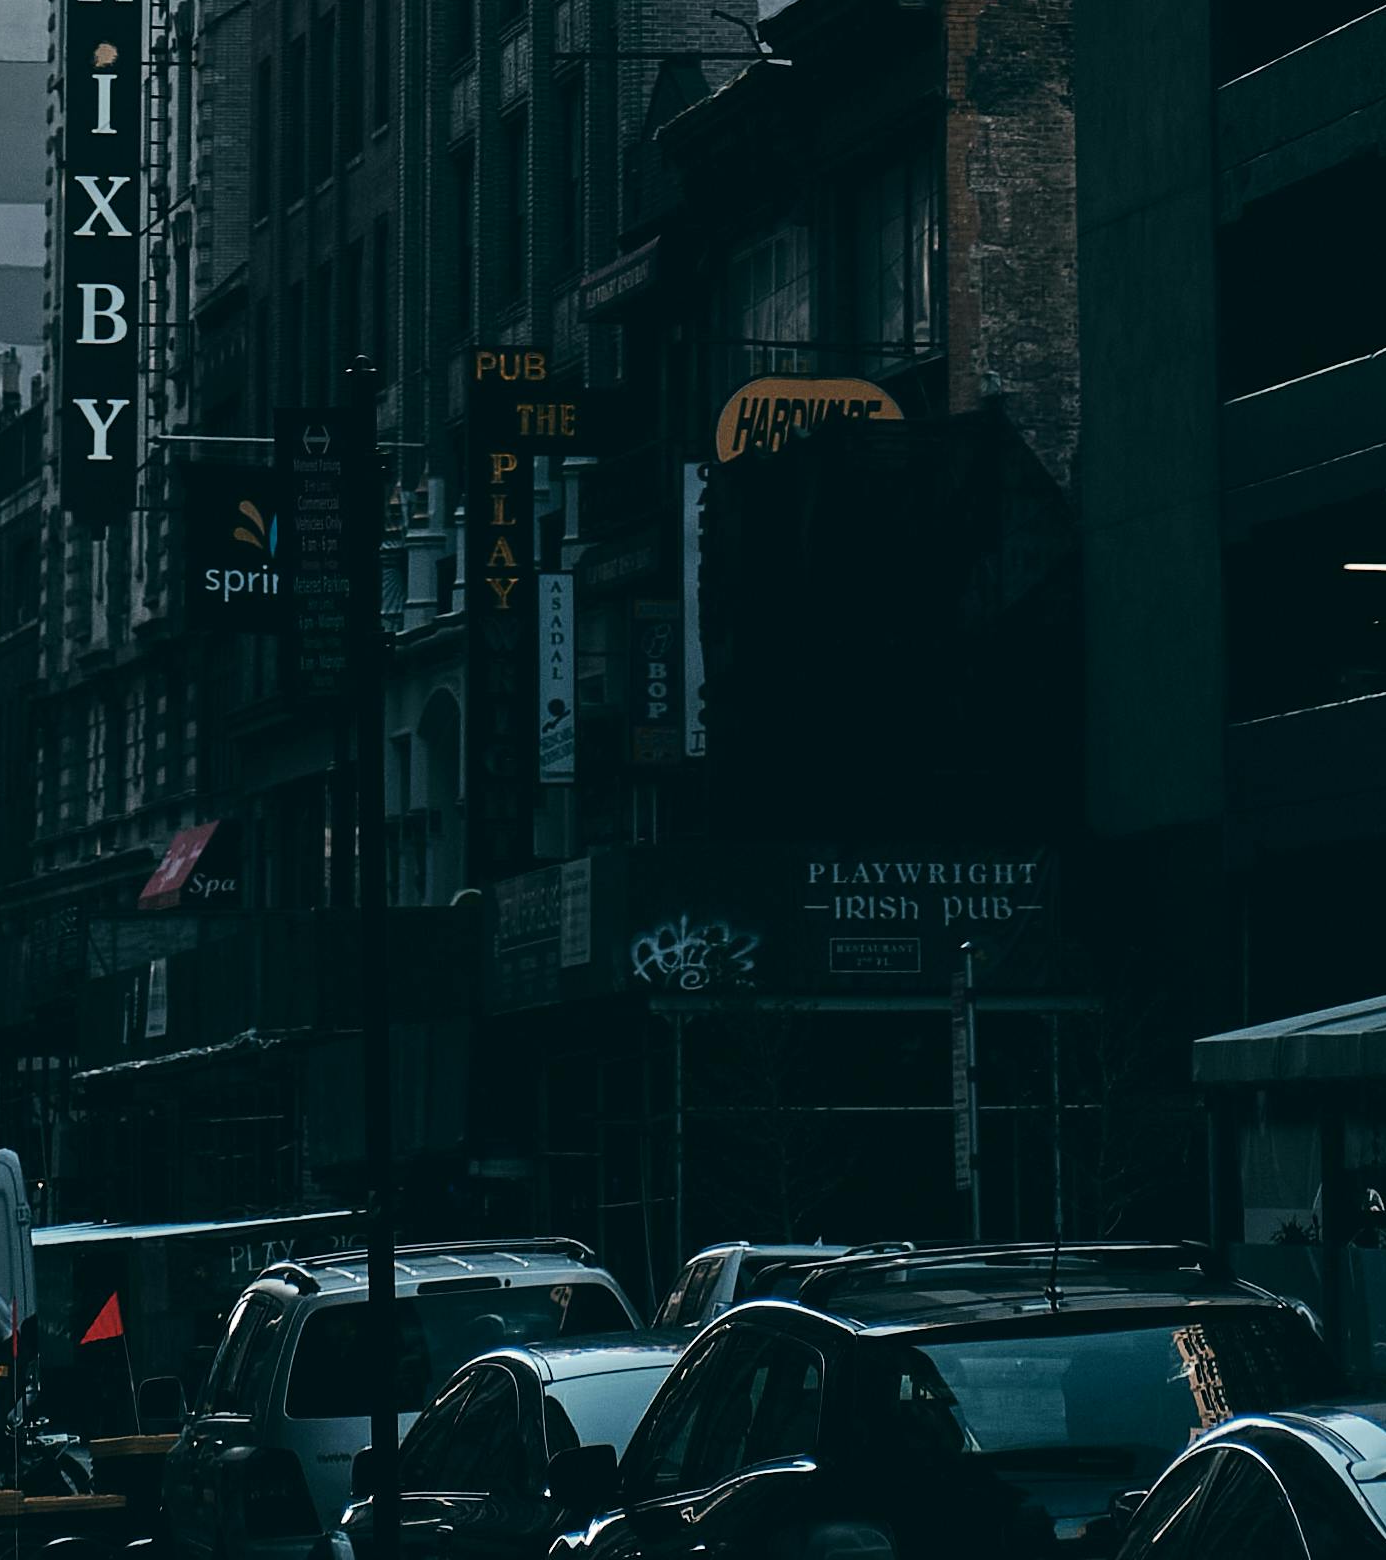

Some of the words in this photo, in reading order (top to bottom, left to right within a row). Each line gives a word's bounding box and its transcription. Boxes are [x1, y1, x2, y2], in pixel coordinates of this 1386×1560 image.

[475, 350, 548, 382] PUB
[516, 403, 577, 437] THE
[550, 580, 564, 681] ASADAL
[646, 661, 668, 720] BOP
[188, 872, 238, 899] Spa
[807, 862, 1038, 884] PLAYWRIGHT
